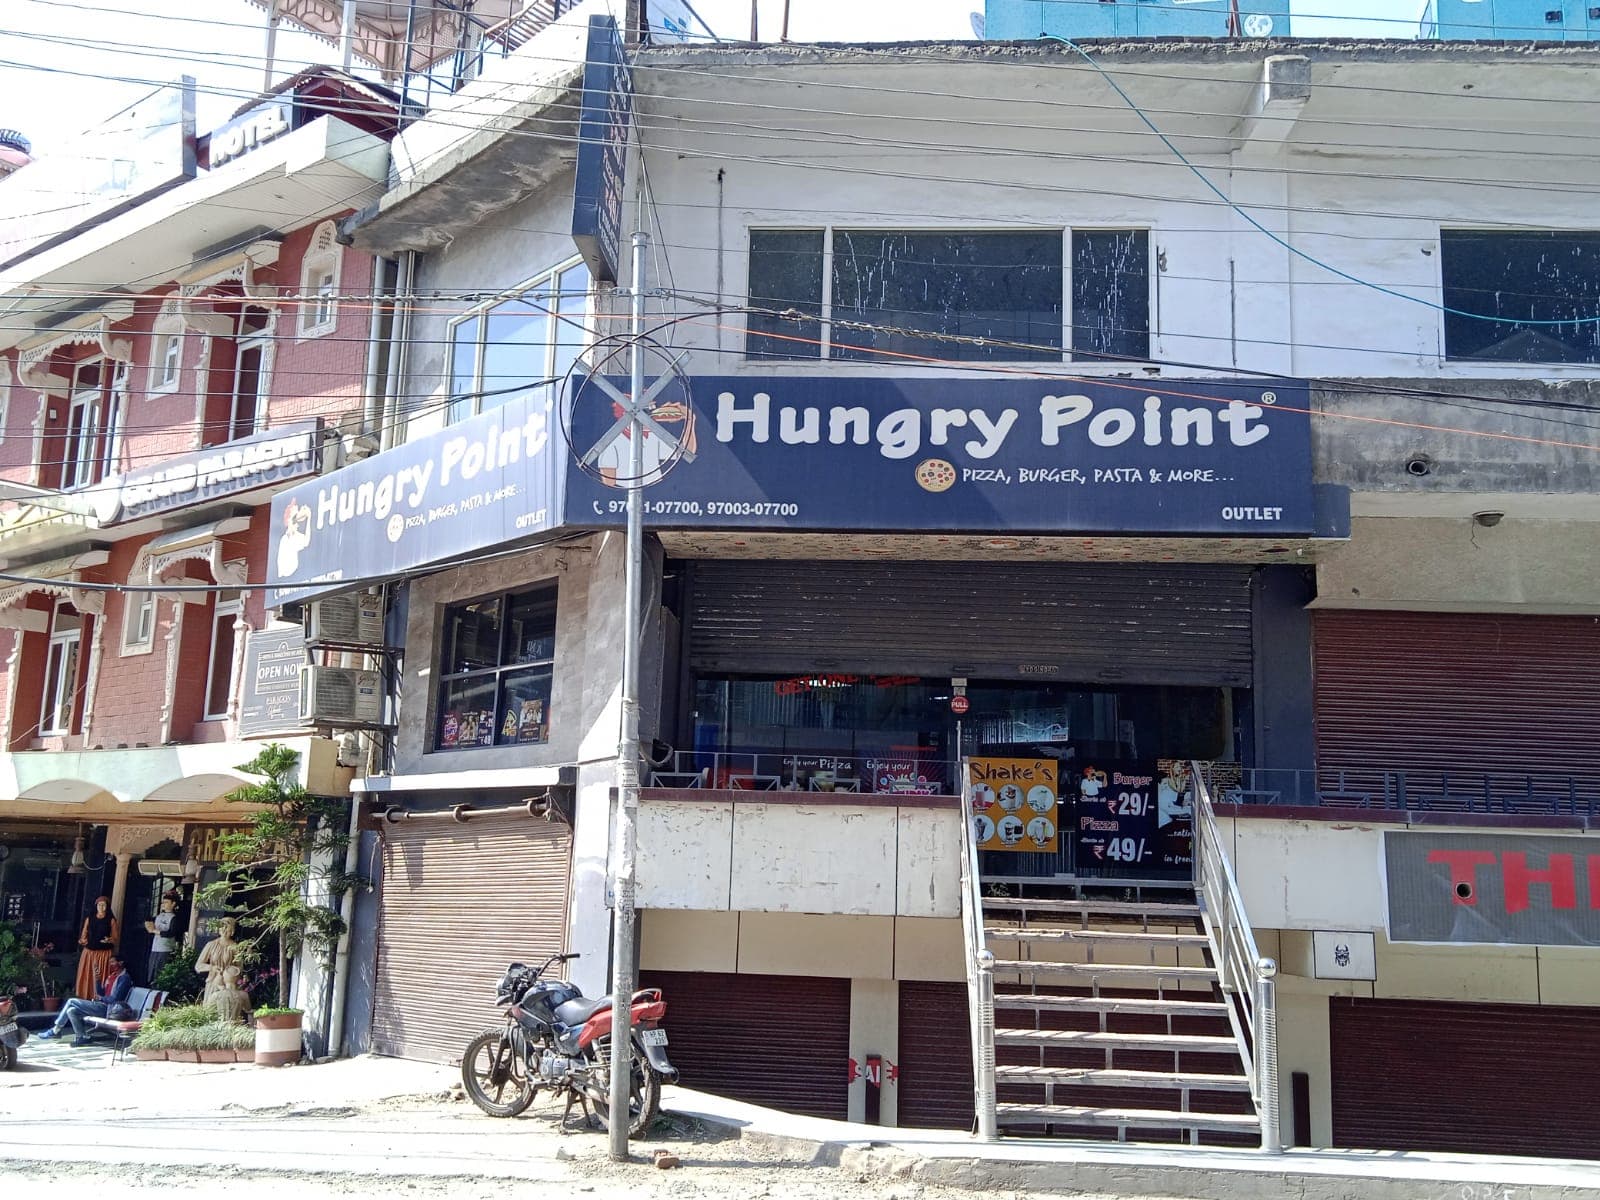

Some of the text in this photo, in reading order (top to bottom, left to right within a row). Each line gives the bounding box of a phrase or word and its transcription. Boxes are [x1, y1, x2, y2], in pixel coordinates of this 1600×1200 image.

[208, 106, 290, 169] HOTEL
[716, 391, 1018, 460] Hungry
[1039, 394, 1270, 448] Point
[316, 411, 549, 530] Hungry Point
[962, 466, 1011, 483] PIZZA,
[1018, 466, 1087, 485] BURGER,
[1094, 467, 1143, 484] PASTA
[1148, 468, 1162, 484] &
[608, 500, 799, 517] 971-07700, 97003-07700
[1221, 506, 1283, 521] OUTLET
[515, 508, 547, 529] OUTLET
[259, 664, 281, 680] OPEN
[1113, 772, 1153, 789] Burger
[1080, 816, 1119, 832] Pizza
